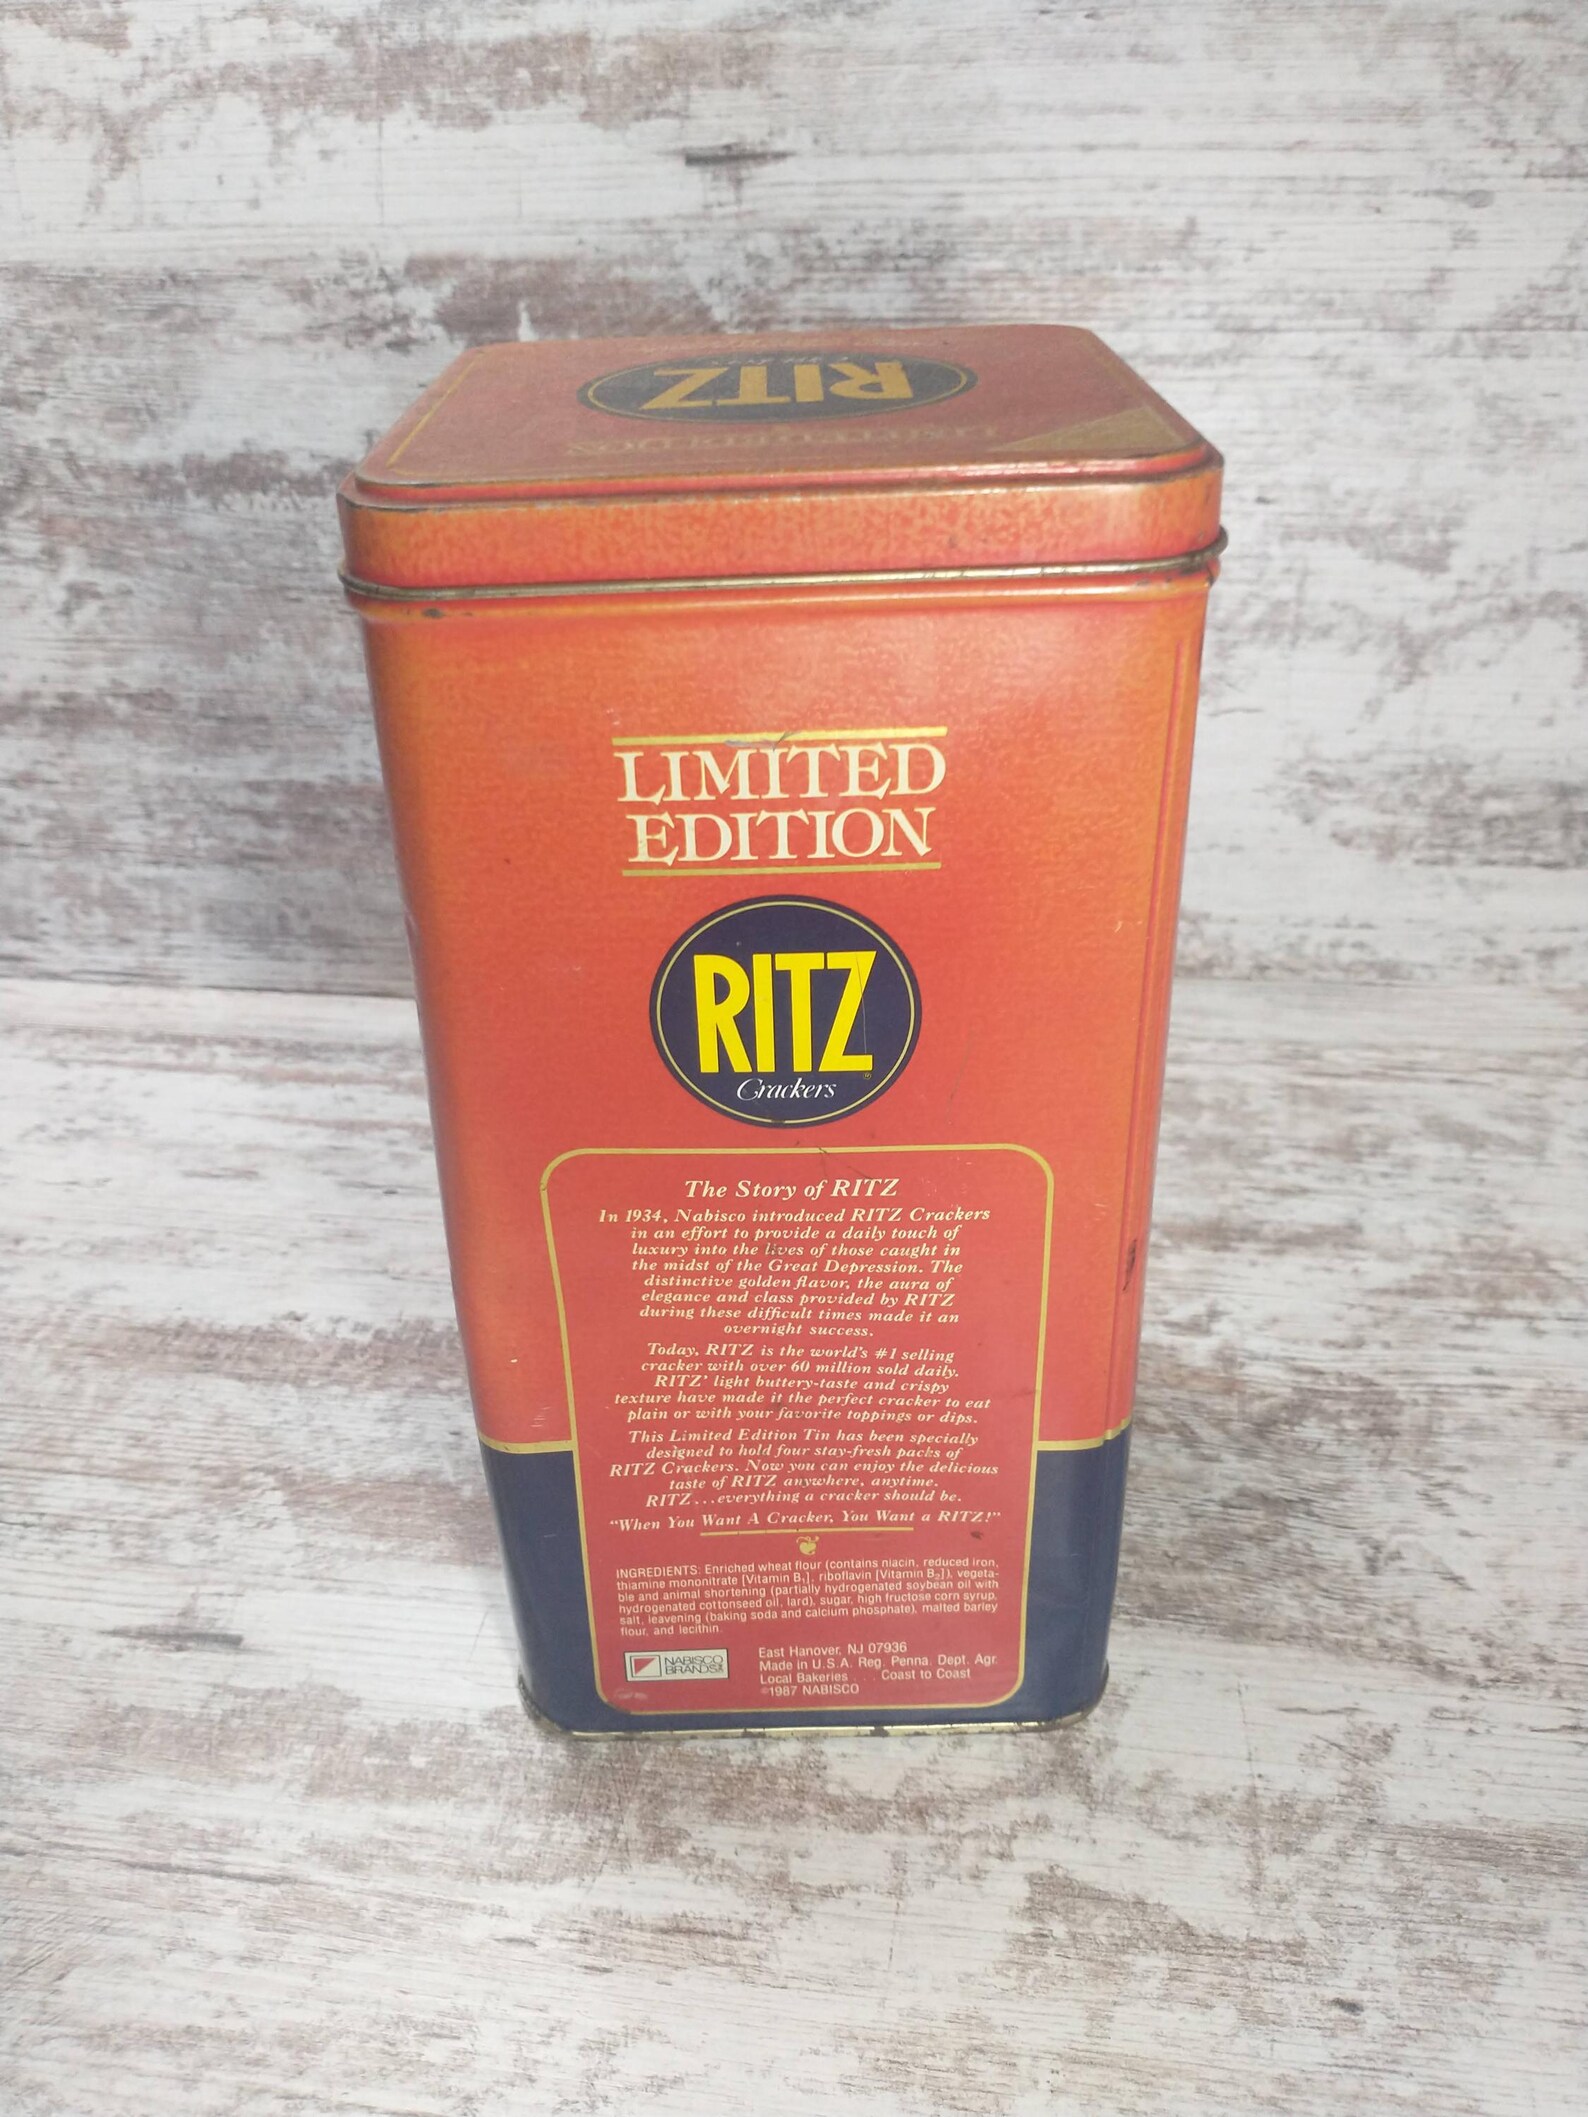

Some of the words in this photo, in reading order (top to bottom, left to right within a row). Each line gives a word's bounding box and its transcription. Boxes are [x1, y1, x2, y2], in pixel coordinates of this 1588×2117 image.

[639, 361, 914, 410] RITZ
[613, 743, 947, 805] LIMITED
[626, 807, 936, 866] EDITION
[693, 950, 877, 1073] RITZ
[736, 1077, 837, 1101] Crackers
[685, 1180, 727, 1198] The
[735, 1179, 796, 1200] Story
[804, 1179, 828, 1200] of
[830, 1178, 900, 1197] RITZ
[625, 1209, 668, 1223] 1934,
[674, 1209, 746, 1222] Nabisco
[752, 1208, 845, 1222] introduced
[850, 1208, 903, 1222] RITZ
[910, 1207, 990, 1221] Crackers
[681, 1226, 727, 1241] effort
[754, 1226, 820, 1241] provide
[843, 1226, 885, 1241] daily
[891, 1226, 937, 1238] touch
[632, 1243, 688, 1257] luxury
[694, 1243, 727, 1255] into
[733, 1244, 758, 1255] the
[831, 1243, 874, 1256] those
[880, 1243, 937, 1259] caught
[632, 1259, 657, 1271] the
[664, 1259, 709, 1271] midst
[736, 1259, 762, 1271] the
[768, 1259, 818, 1272] Great
[824, 1259, 924, 1275] Depression.
[931, 1260, 963, 1273] The
[644, 1274, 733, 1287] distinctive
[739, 1275, 791, 1289] golden
[794, 1276, 850, 1290] flavor,
[858, 1276, 883, 1289] the
[889, 1279, 929, 1289] aura
[641, 1290, 711, 1303] elegance
[716, 1291, 748, 1302] and
[754, 1292, 794, 1302] class
[800, 1293, 875, 1306] provided
[904, 1294, 955, 1306] RITZ
[640, 1305, 695, 1319] during
[700, 1306, 741, 1318] these
[748, 1307, 812, 1320] difficult
[819, 1309, 862, 1321] times
[868, 1310, 913, 1322] made
[724, 1323, 802, 1336] overnight
[809, 1326, 874, 1337] success.
[648, 1343, 699, 1357] Today,
[705, 1344, 754, 1356] RITZ
[779, 1345, 804, 1357] the
[875, 1348, 897, 1360] #1
[901, 1349, 955, 1363] selling
[641, 1359, 703, 1371] cracker
[707, 1360, 744, 1371] with
[750, 1362, 786, 1372] over
[791, 1361, 810, 1372] 60
[815, 1361, 871, 1374] million
[877, 1364, 910, 1376] sold
[914, 1364, 959, 1379] daily.
[713, 1375, 750, 1389] light
[756, 1376, 858, 1390] buttery-taste
[864, 1380, 896, 1390] and
[901, 1381, 949, 1394] crispy
[615, 1393, 672, 1404] texture
[677, 1391, 716, 1403] have
[722, 1391, 764, 1403] made
[789, 1392, 813, 1404] the
[818, 1393, 873, 1406] perfect
[878, 1395, 940, 1407] cracker
[965, 1399, 991, 1408] eat
[627, 1408, 668, 1423] plain
[696, 1407, 732, 1419] with
[736, 1409, 773, 1421] your
[776, 1407, 841, 1421] favorite
[847, 1409, 912, 1423] toppings
[939, 1411, 978, 1425] dips.
[629, 1430, 664, 1443] This
[669, 1429, 733, 1442] Limited
[738, 1428, 797, 1440] Edition
[804, 1429, 830, 1440] Tin
[836, 1430, 864, 1441] has
[869, 1430, 904, 1442] been
[910, 1433, 979, 1446] specially
[646, 1445, 714, 1460] designed
[738, 1444, 772, 1456] hold
[775, 1445, 811, 1458] four
[814, 1446, 891, 1457] stay-fresh
[896, 1447, 940, 1459] packs
[610, 1463, 656, 1477] RITZ
[662, 1460, 740, 1473] Crackers.
[745, 1460, 784, 1471] Now
[787, 1461, 815, 1473] you
[820, 1463, 848, 1471] can
[854, 1462, 895, 1473] enjoy
[900, 1461, 924, 1472] the
[929, 1462, 999, 1474] delicious
[669, 1478, 706, 1490] taste
[731, 1475, 778, 1488] RITZ
[783, 1474, 865, 1488] anywhere,
[871, 1476, 939, 1488] anytime.
[820, 1489, 880, 1501] cracker
[884, 1490, 936, 1501] should
[940, 1490, 962, 1502] be.
[668, 1516, 695, 1529] You
[700, 1513, 741, 1526] Want
[767, 1511, 834, 1524] Cracker,
[842, 1510, 869, 1522] You
[876, 1510, 915, 1522] Want
[616, 1565, 700, 1579] INGREDIENTS:
[705, 1563, 755, 1575] Enriched
[758, 1562, 792, 1572] wheat
[795, 1560, 822, 1571] flour
[826, 1558, 878, 1570] (contains
[923, 1557, 969, 1568] reduced
[616, 1580, 666, 1591] thiamine
[669, 1576, 737, 1588] mononitrate
[742, 1574, 790, 1587] [Vitamin
[819, 1570, 872, 1582] riboflavin
[875, 1569, 923, 1582] [Vitamin
[957, 1569, 1000, 1580] vegeta-
[638, 1591, 659, 1601] and
[663, 1589, 700, 1600] animal
[705, 1587, 766, 1600] shortening
[771, 1584, 820, 1597] (partially
[825, 1581, 902, 1593] hydrogenated
[906, 1580, 953, 1592] soybean
[975, 1580, 999, 1589] with
[619, 1601, 695, 1615] hydrogenated
[699, 1598, 762, 1610] cottonseed
[858, 1593, 882, 1605] high
[885, 1593, 931, 1602] fructose
[935, 1592, 959, 1601] corn
[649, 1613, 701, 1625] leavening
[705, 1610, 747, 1623] (baking
[751, 1608, 778, 1620] soda
[781, 1607, 806, 1618] and
[805, 1606, 849, 1617] calcium
[922, 1601, 960, 1613] malted
[964, 1600, 998, 1613] barley
[653, 1623, 674, 1635] and
[759, 1646, 784, 1658] East
[847, 1642, 864, 1655] NJ
[868, 1641, 908, 1654] 07936
[664, 1655, 724, 1666] NABISCO
[759, 1660, 793, 1672] Made
[760, 1672, 792, 1685] Local
[797, 1671, 848, 1683] Bakeries
[881, 1668, 916, 1681] Coast
[936, 1667, 971, 1679] Coast
[803, 1683, 859, 1696] NABISCO
